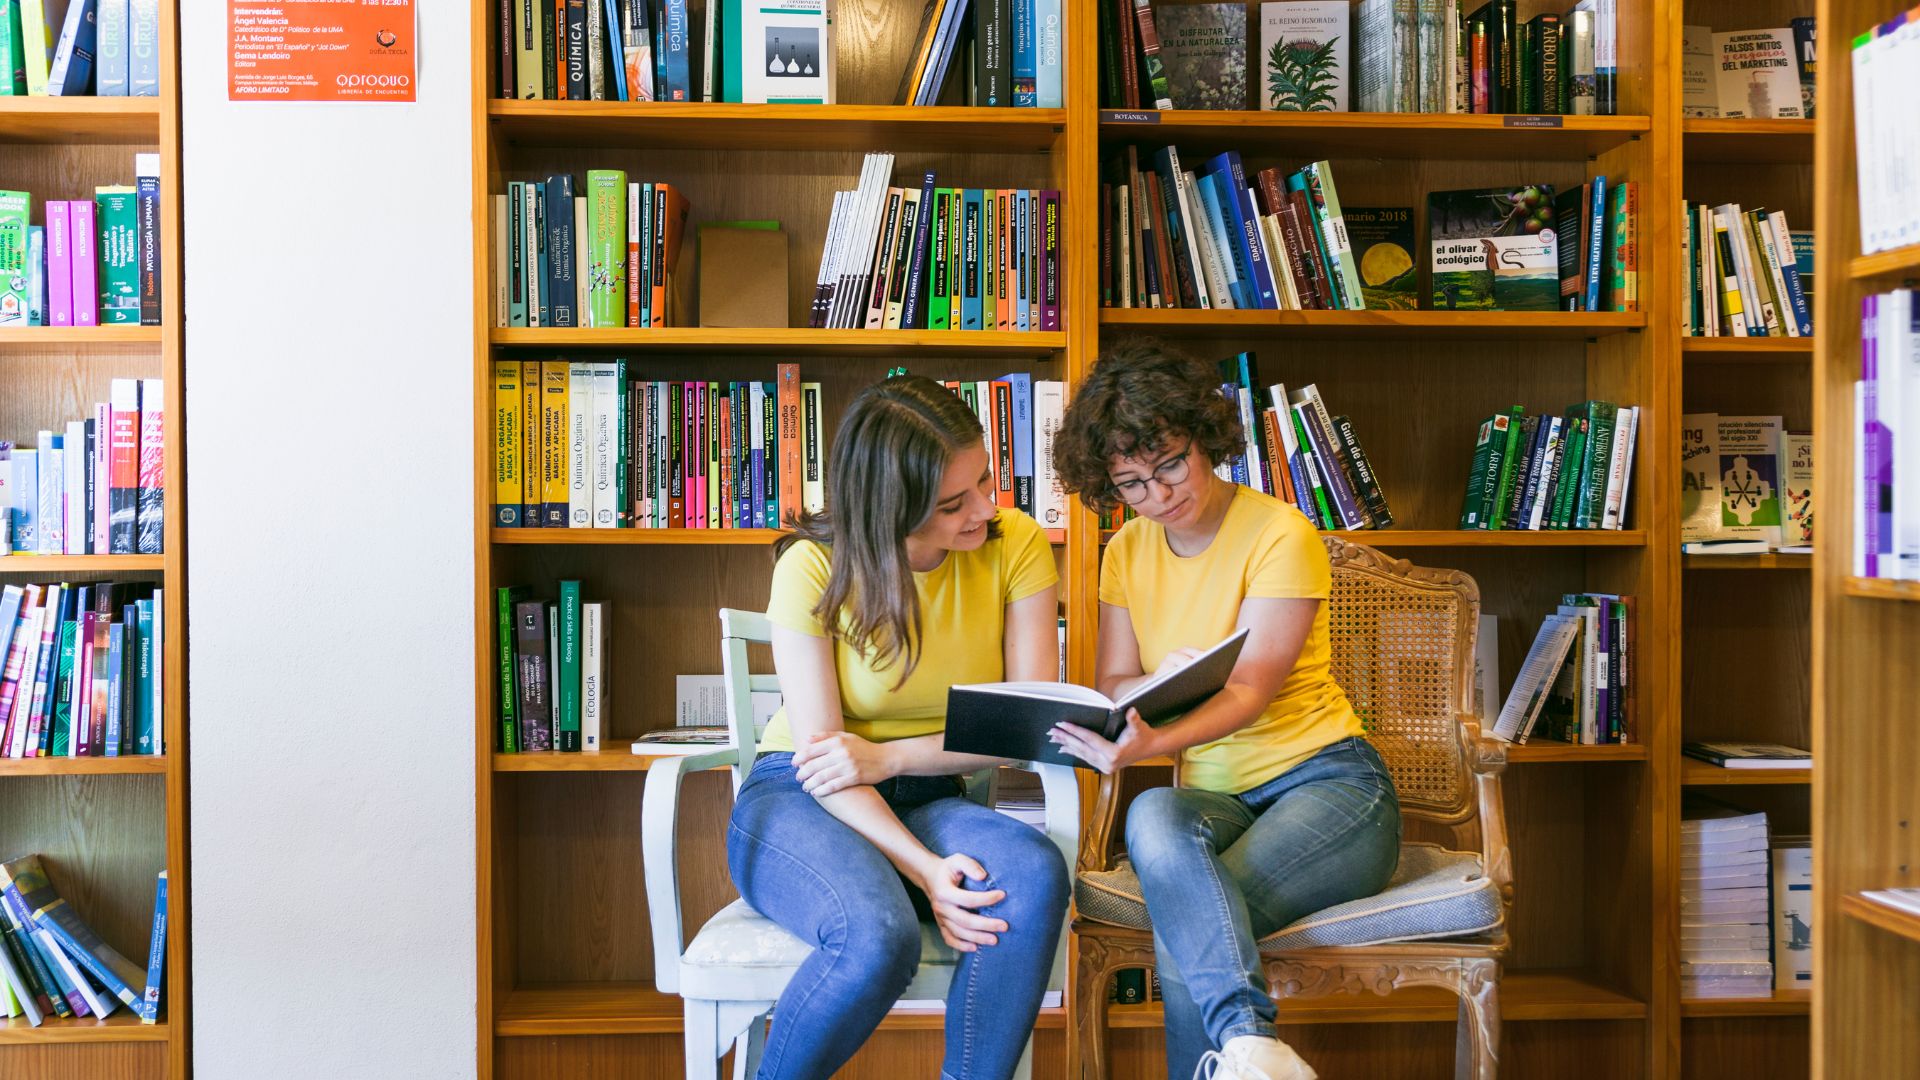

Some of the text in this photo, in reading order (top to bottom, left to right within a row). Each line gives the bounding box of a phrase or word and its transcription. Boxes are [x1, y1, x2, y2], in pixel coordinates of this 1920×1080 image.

[234, 17, 256, 25] Ángel
[1180, 28, 1224, 37] DISFRUTAR
[1279, 17, 1300, 25] REINO
[1301, 16, 1338, 25] IGNORADO
[1164, 40, 1174, 48] EN
[1188, 37, 1241, 46] NATURALEZA
[1723, 40, 1783, 53] FALSOS MITOS
[1729, 33, 1774, 43] ALIMENTACIÓN:
[569, 21, 584, 82] QUÍMICA
[1542, 25, 1560, 82] ÁRBOLES
[1722, 54, 1731, 62] y
[1722, 58, 1789, 71] DEL MARKETING
[1114, 112, 1148, 121] BOTÁNICA
[145, 196, 153, 229] HUMANA
[966, 219, 974, 241] Orgánica
[1244, 219, 1260, 262] EDAFOLOGÍA
[552, 227, 561, 279] Fundamentos de
[560, 224, 570, 282] Química Orgánica
[966, 242, 974, 262] Química
[1285, 227, 1304, 278] PISTACHO
[1436, 244, 1478, 255] el olivar
[1436, 255, 1485, 266] ecológico
[1591, 215, 1603, 284] NUEVA OLIVICULTURA
[910, 271, 919, 298] GENERAL
[905, 298, 916, 324] QUÍMICA
[790, 405, 798, 439] Química
[497, 407, 505, 483] QUÍMICA ORGÁNICA
[543, 406, 552, 483] QUÍMICA ORGÁNICA
[573, 413, 585, 490] Química Orgánica
[597, 414, 609, 491] Química Orgánica
[1263, 415, 1277, 465] MINISCAPES
[1350, 445, 1361, 461] de
[505, 453, 513, 479] BÁSICA
[552, 453, 560, 479] BÁSICA
[1355, 459, 1371, 484] aves
[1484, 448, 1502, 494] ÁRBOLES
[1511, 455, 1529, 512] AVES DE EUROPA
[566, 596, 574, 620] Practical
[566, 620, 574, 636] Skills
[141, 637, 149, 679] Fitoterapia
[501, 645, 510, 666] Tierra
[565, 642, 574, 663] Biology
[503, 672, 510, 680] de
[503, 681, 511, 710] Ciencias
[586, 675, 596, 718] ECOLOGÍA
